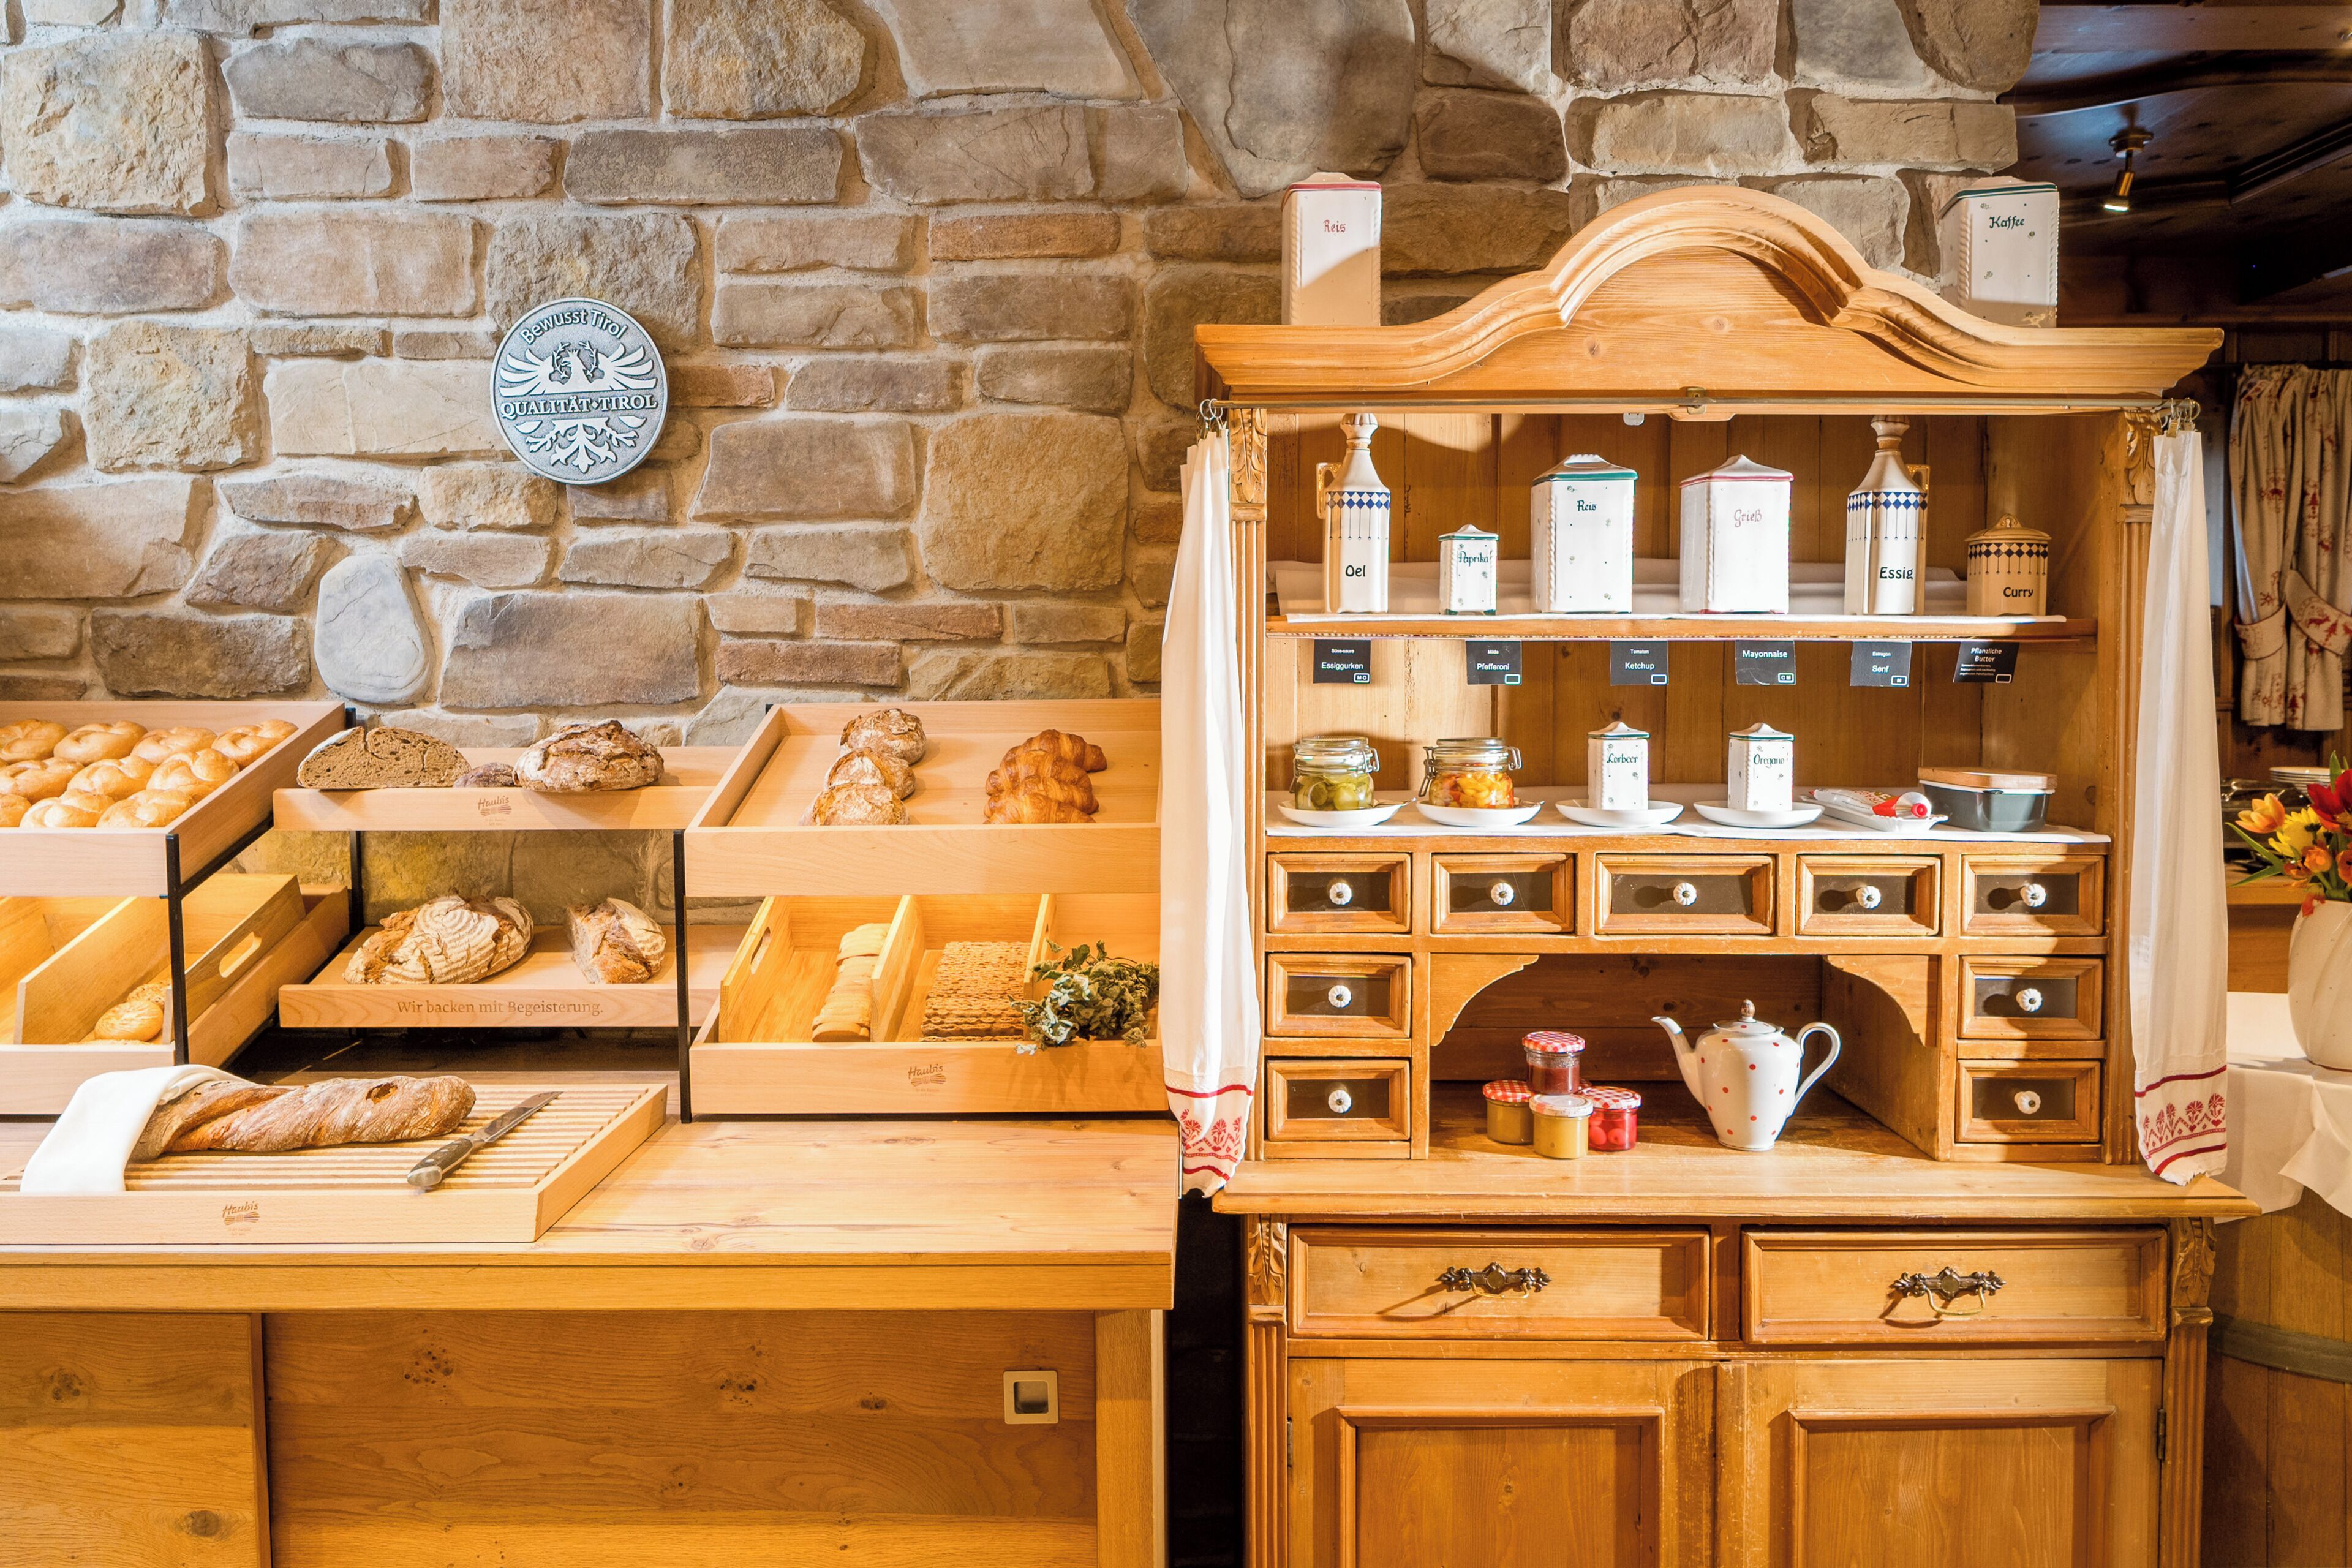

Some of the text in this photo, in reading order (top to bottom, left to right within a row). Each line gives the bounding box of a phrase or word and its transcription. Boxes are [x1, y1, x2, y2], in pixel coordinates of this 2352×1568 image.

[1322, 219, 1346, 233] Reis
[1989, 215, 2026, 230] Kaffee
[520, 309, 627, 344] Bewusst Tirol
[598, 394, 658, 412] TIROL
[1577, 499, 1597, 512] Reis
[1733, 509, 1762, 528] Grieß
[1458, 551, 1489, 567] Paprika
[1345, 564, 1366, 577] Oel
[1879, 567, 1913, 580] Essig
[2003, 586, 2034, 598] Curry
[1743, 650, 1788, 658] Mayonnaise
[1321, 662, 1363, 671] Essiggurken
[1625, 662, 1655, 671] Ketchup
[1607, 753, 1638, 764] Lorbeer
[1754, 753, 1784, 769] Oregano
[397, 1000, 603, 1017] Wir backen mit Begeisterung.
